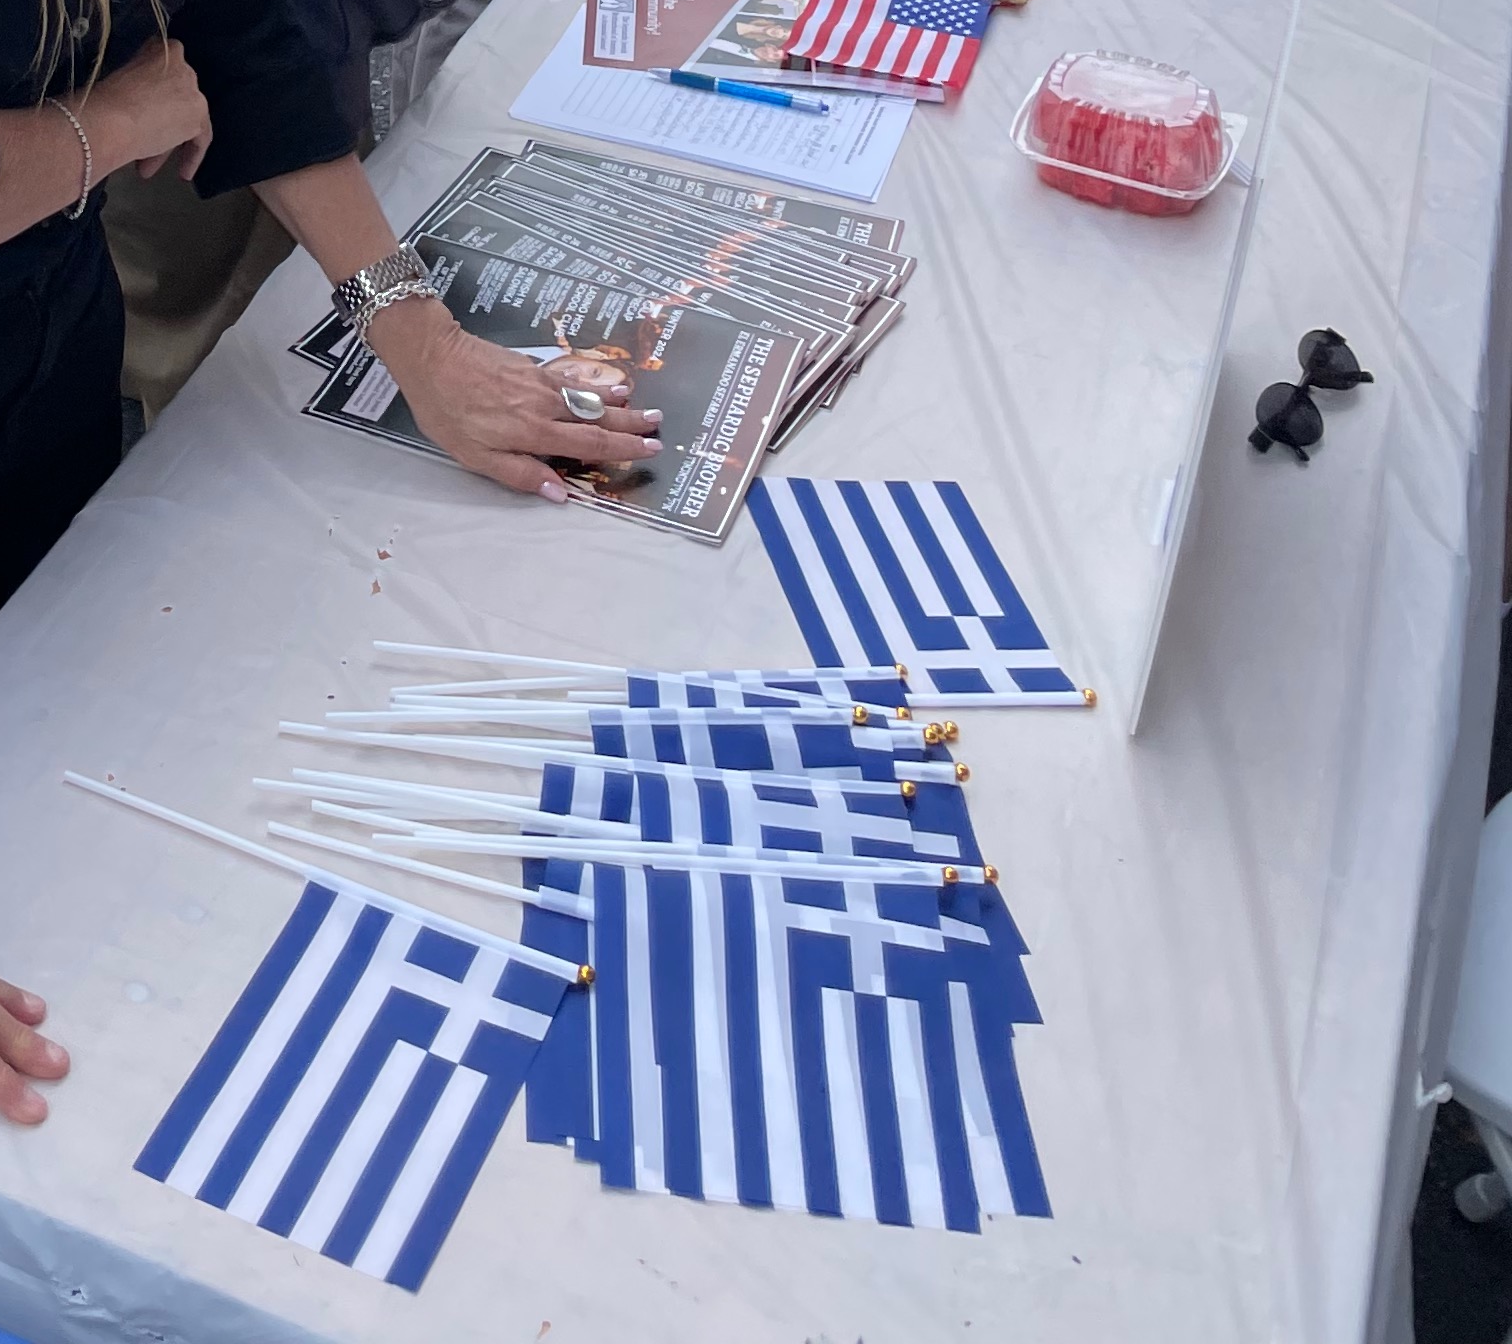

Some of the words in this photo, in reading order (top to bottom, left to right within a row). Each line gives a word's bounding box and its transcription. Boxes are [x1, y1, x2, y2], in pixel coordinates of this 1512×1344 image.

[499, 265, 529, 304] SALONIKA
[516, 268, 539, 299] JEWISH
[564, 281, 588, 315] SCHOOL
[576, 284, 599, 314] LADINO
[510, 296, 524, 309] IN
[552, 313, 572, 338] CLUB
[566, 313, 585, 337] HIGH
[659, 308, 684, 341] WINTER
[736, 329, 750, 341] EL
[648, 339, 667, 362] 2024
[717, 338, 747, 388] ERMANADO
[747, 335, 774, 366] THE
[700, 385, 727, 428] SEFARADI
[711, 365, 762, 453] SEPHARDIC
[680, 449, 726, 519] BROTHER
